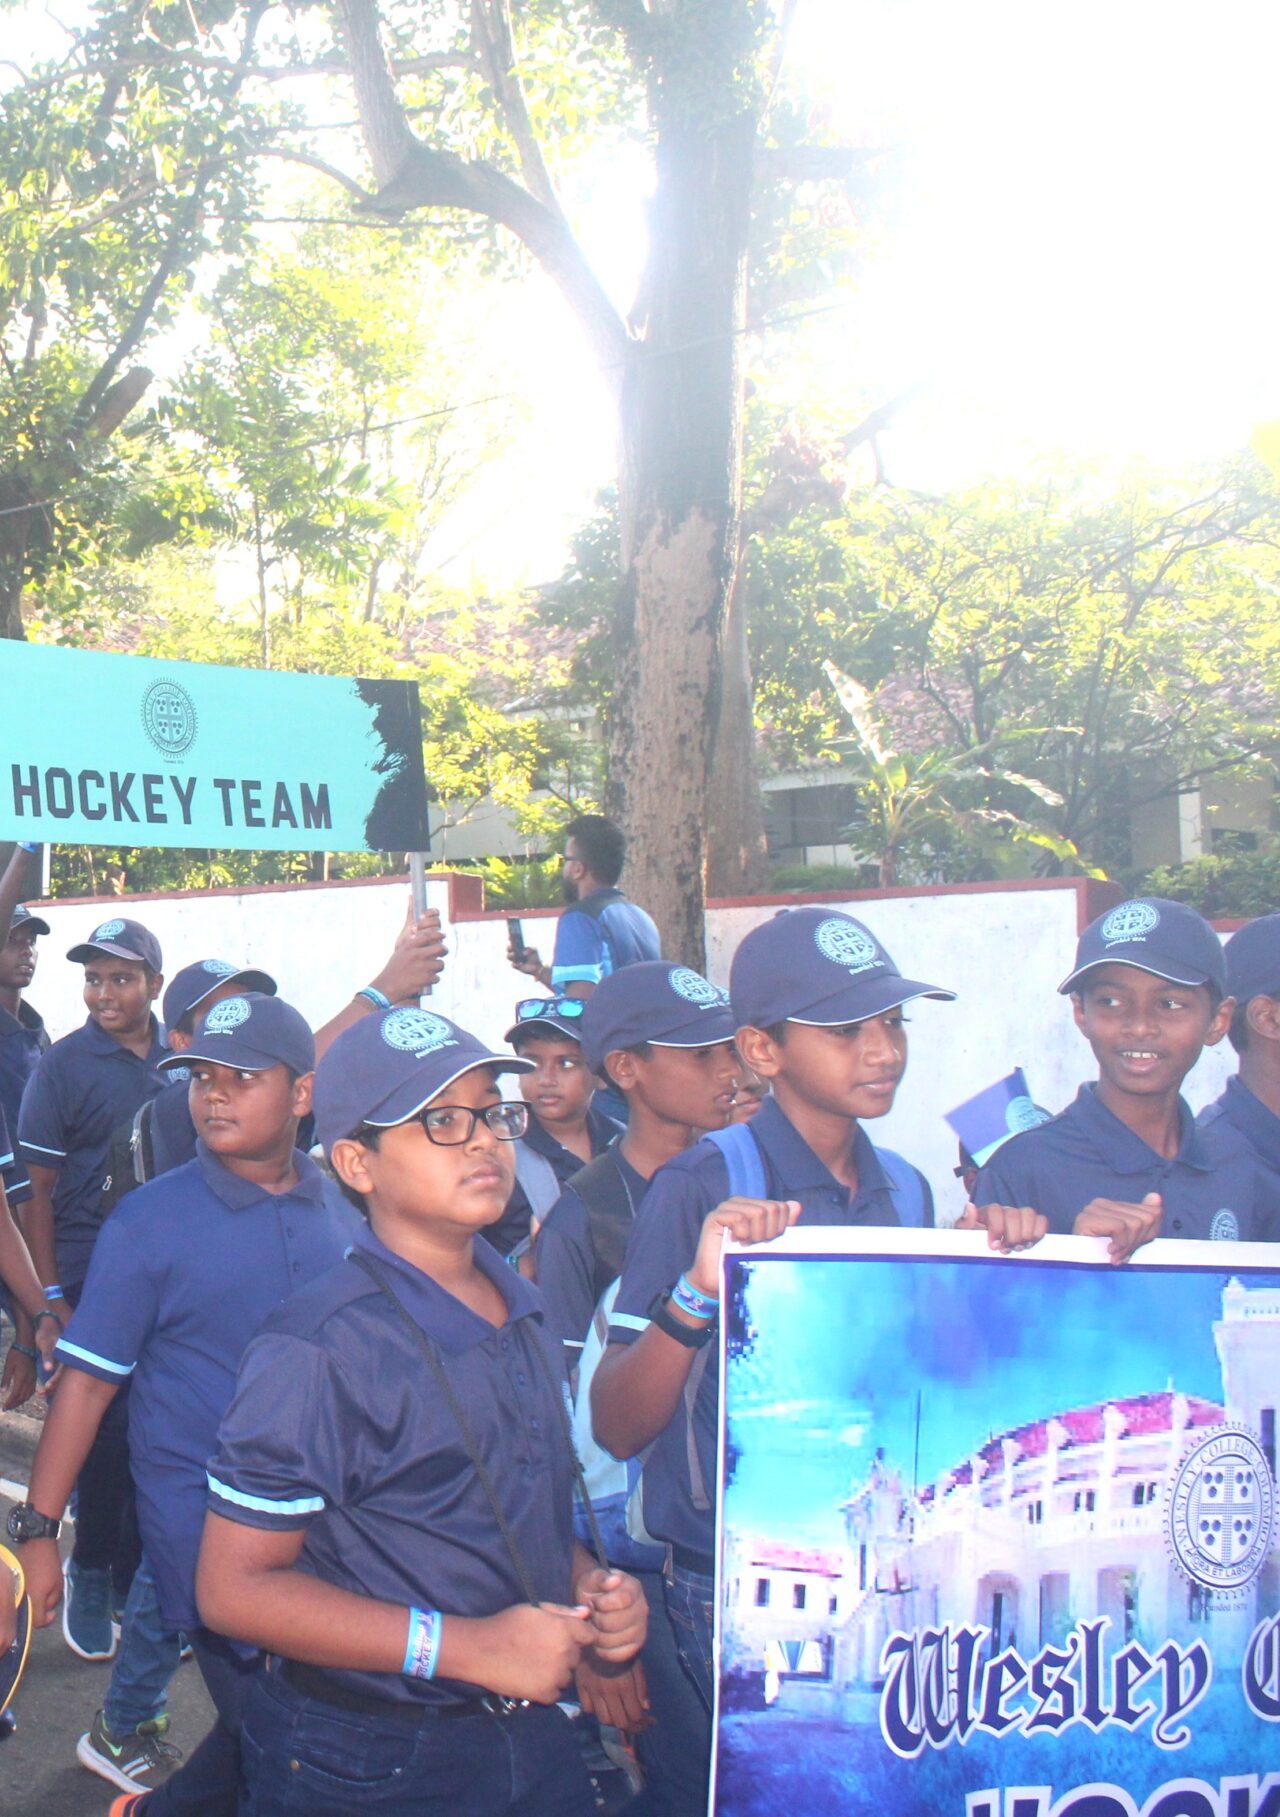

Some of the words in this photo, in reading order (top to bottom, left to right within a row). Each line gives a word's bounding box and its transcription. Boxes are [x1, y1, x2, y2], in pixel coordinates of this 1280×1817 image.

[11, 763, 197, 825] HOCKEY
[213, 777, 333, 831] TEAM
[1199, 1438, 1255, 1464] COLLEGE
[882, 1616, 1211, 1758] Wesley
